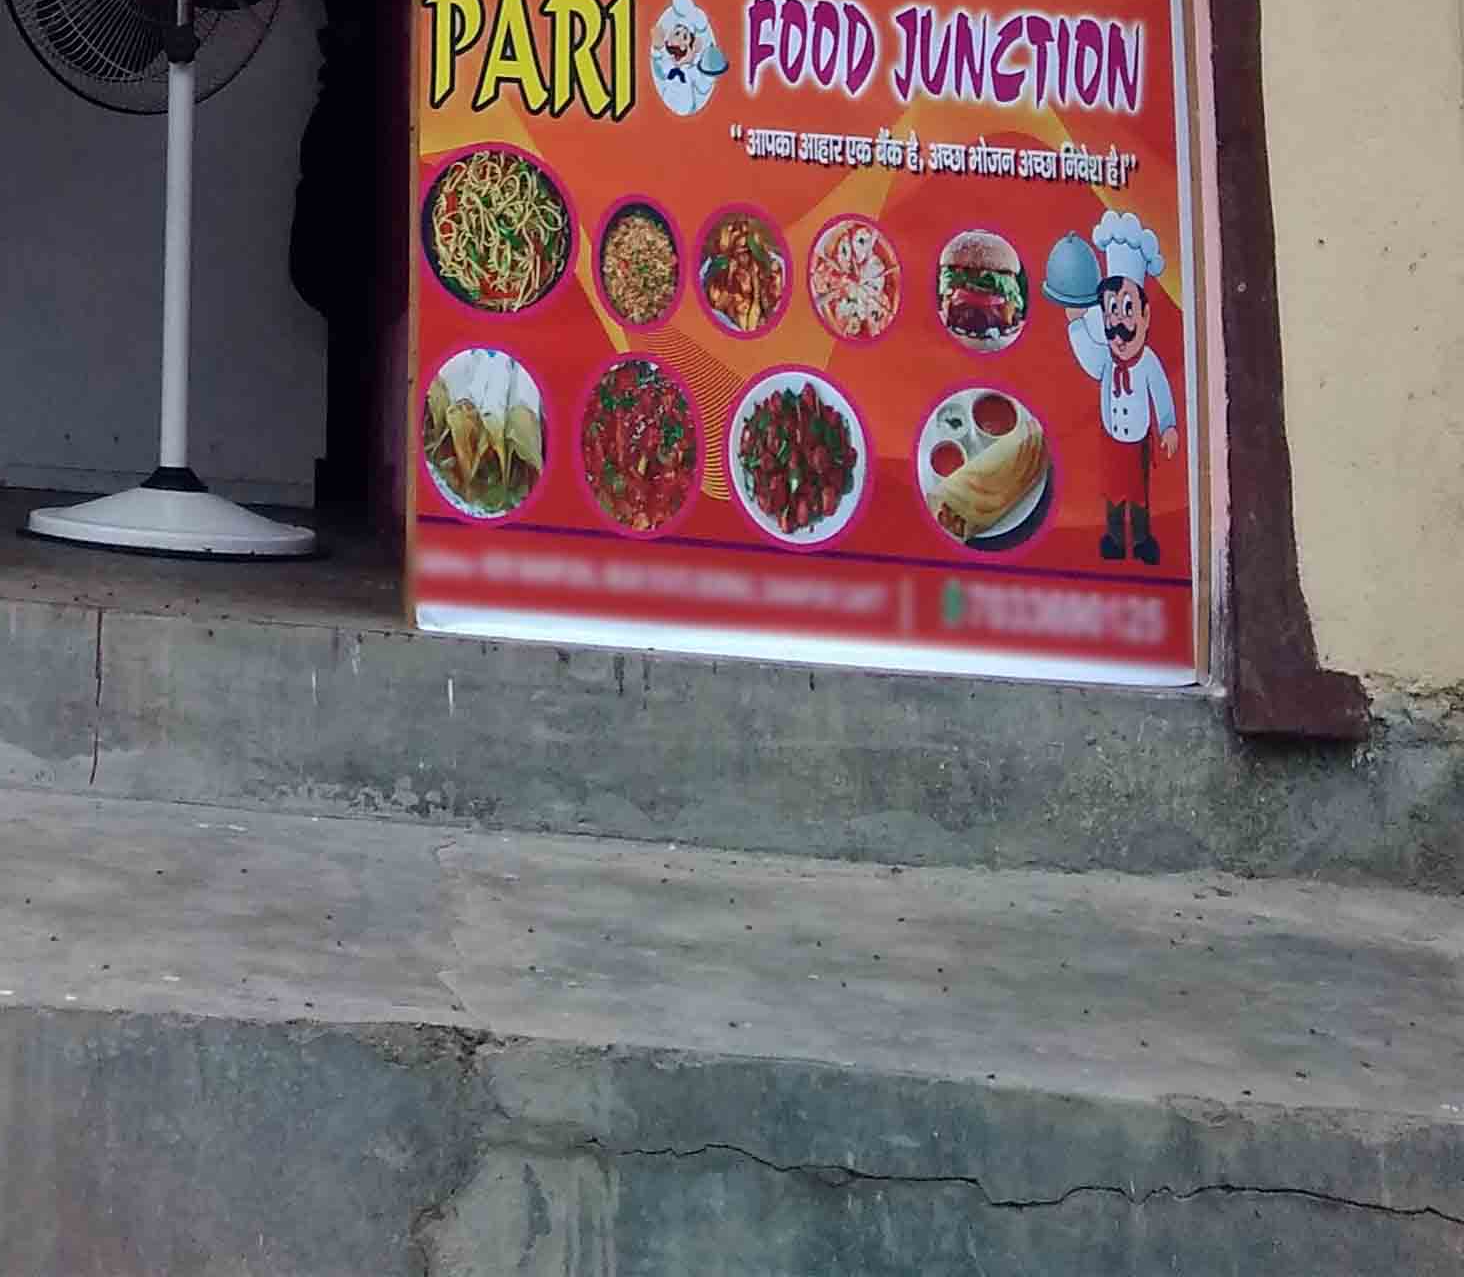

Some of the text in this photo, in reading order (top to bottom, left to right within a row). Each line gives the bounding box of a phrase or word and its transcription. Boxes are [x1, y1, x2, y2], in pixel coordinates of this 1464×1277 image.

[894, 5, 1144, 112] JUNCTION
[746, 128, 798, 159] आपका
[800, 132, 844, 165] आहार
[844, 135, 873, 166] एक
[875, 127, 906, 167] बैंक
[928, 142, 967, 174] अच्छा
[969, 136, 1017, 177] भोजन
[1018, 146, 1058, 181] अच्छा
[1060, 140, 1103, 184] निवेश
